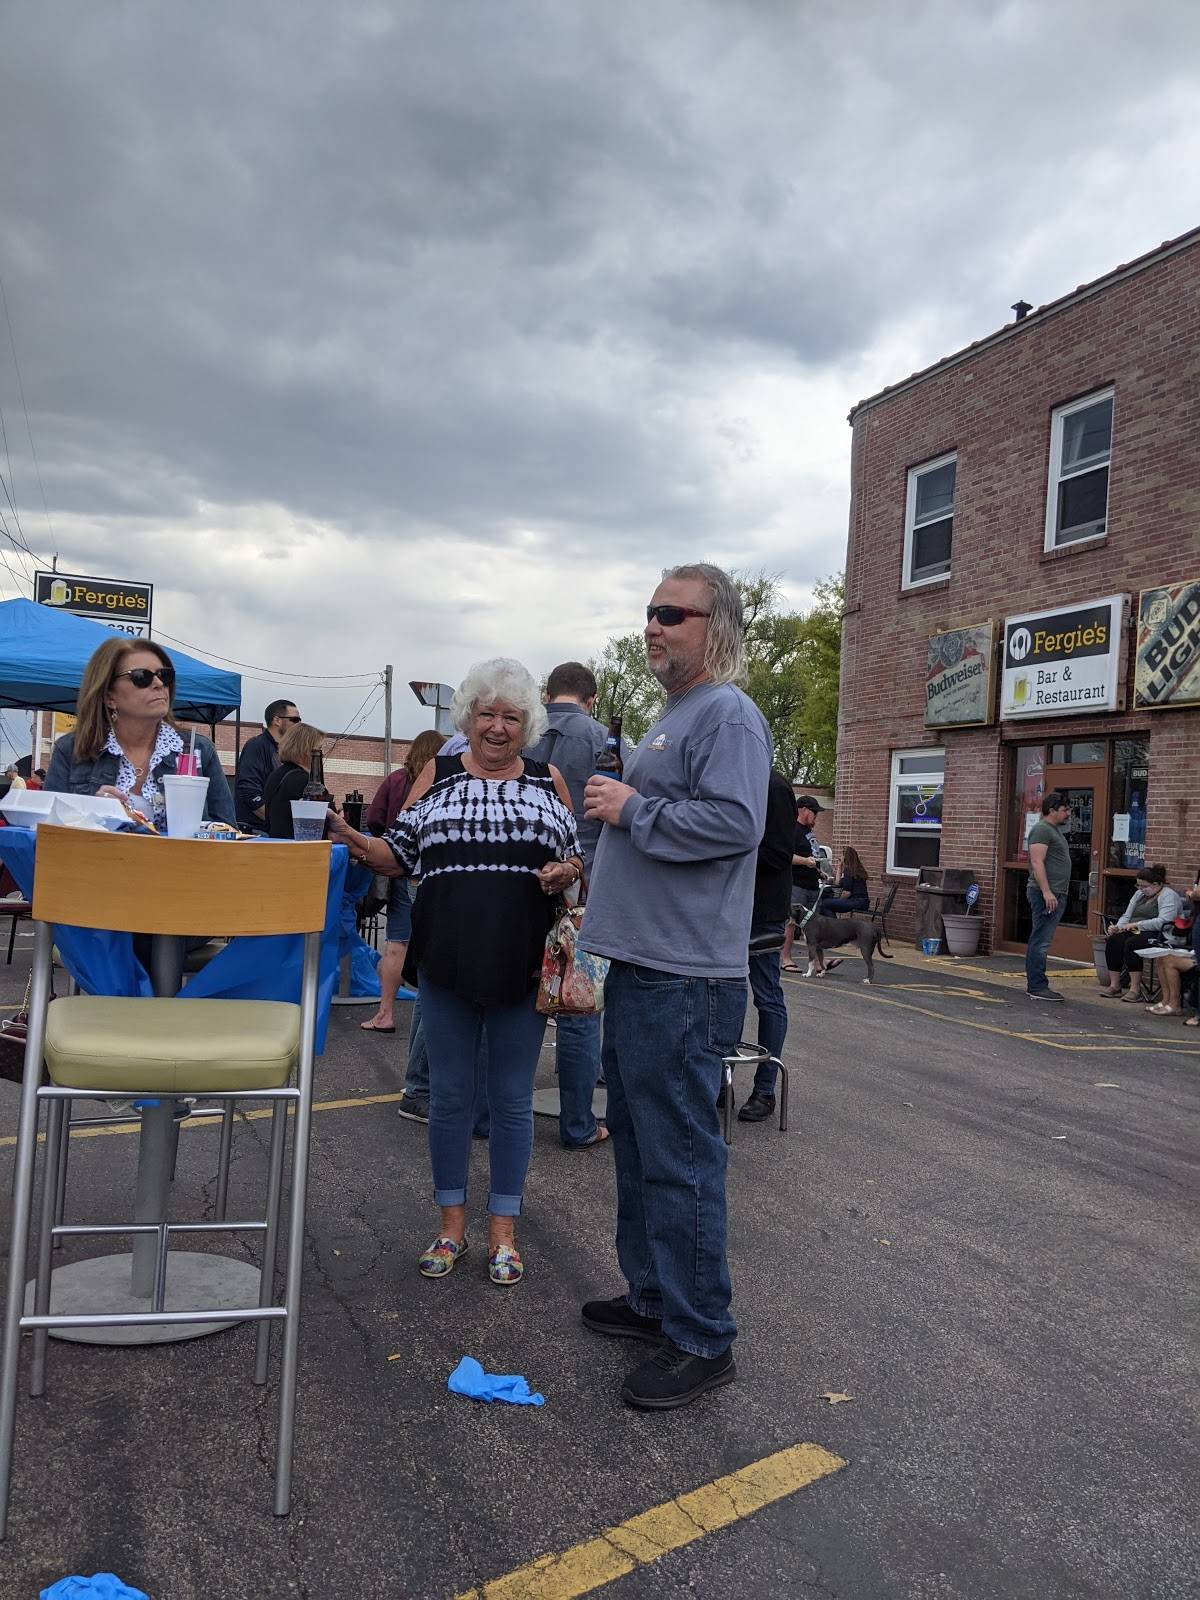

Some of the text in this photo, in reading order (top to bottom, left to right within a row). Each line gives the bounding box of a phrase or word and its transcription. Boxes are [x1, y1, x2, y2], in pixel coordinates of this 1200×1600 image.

[73, 586, 147, 609] Fergie's
[1033, 620, 1107, 654] Fergie's
[1143, 591, 1200, 673] BUD
[927, 662, 982, 700] Budweiser
[1036, 665, 1073, 685] Bar &
[1035, 683, 1105, 705] Restaurant
[1132, 769, 1148, 777] BUD
